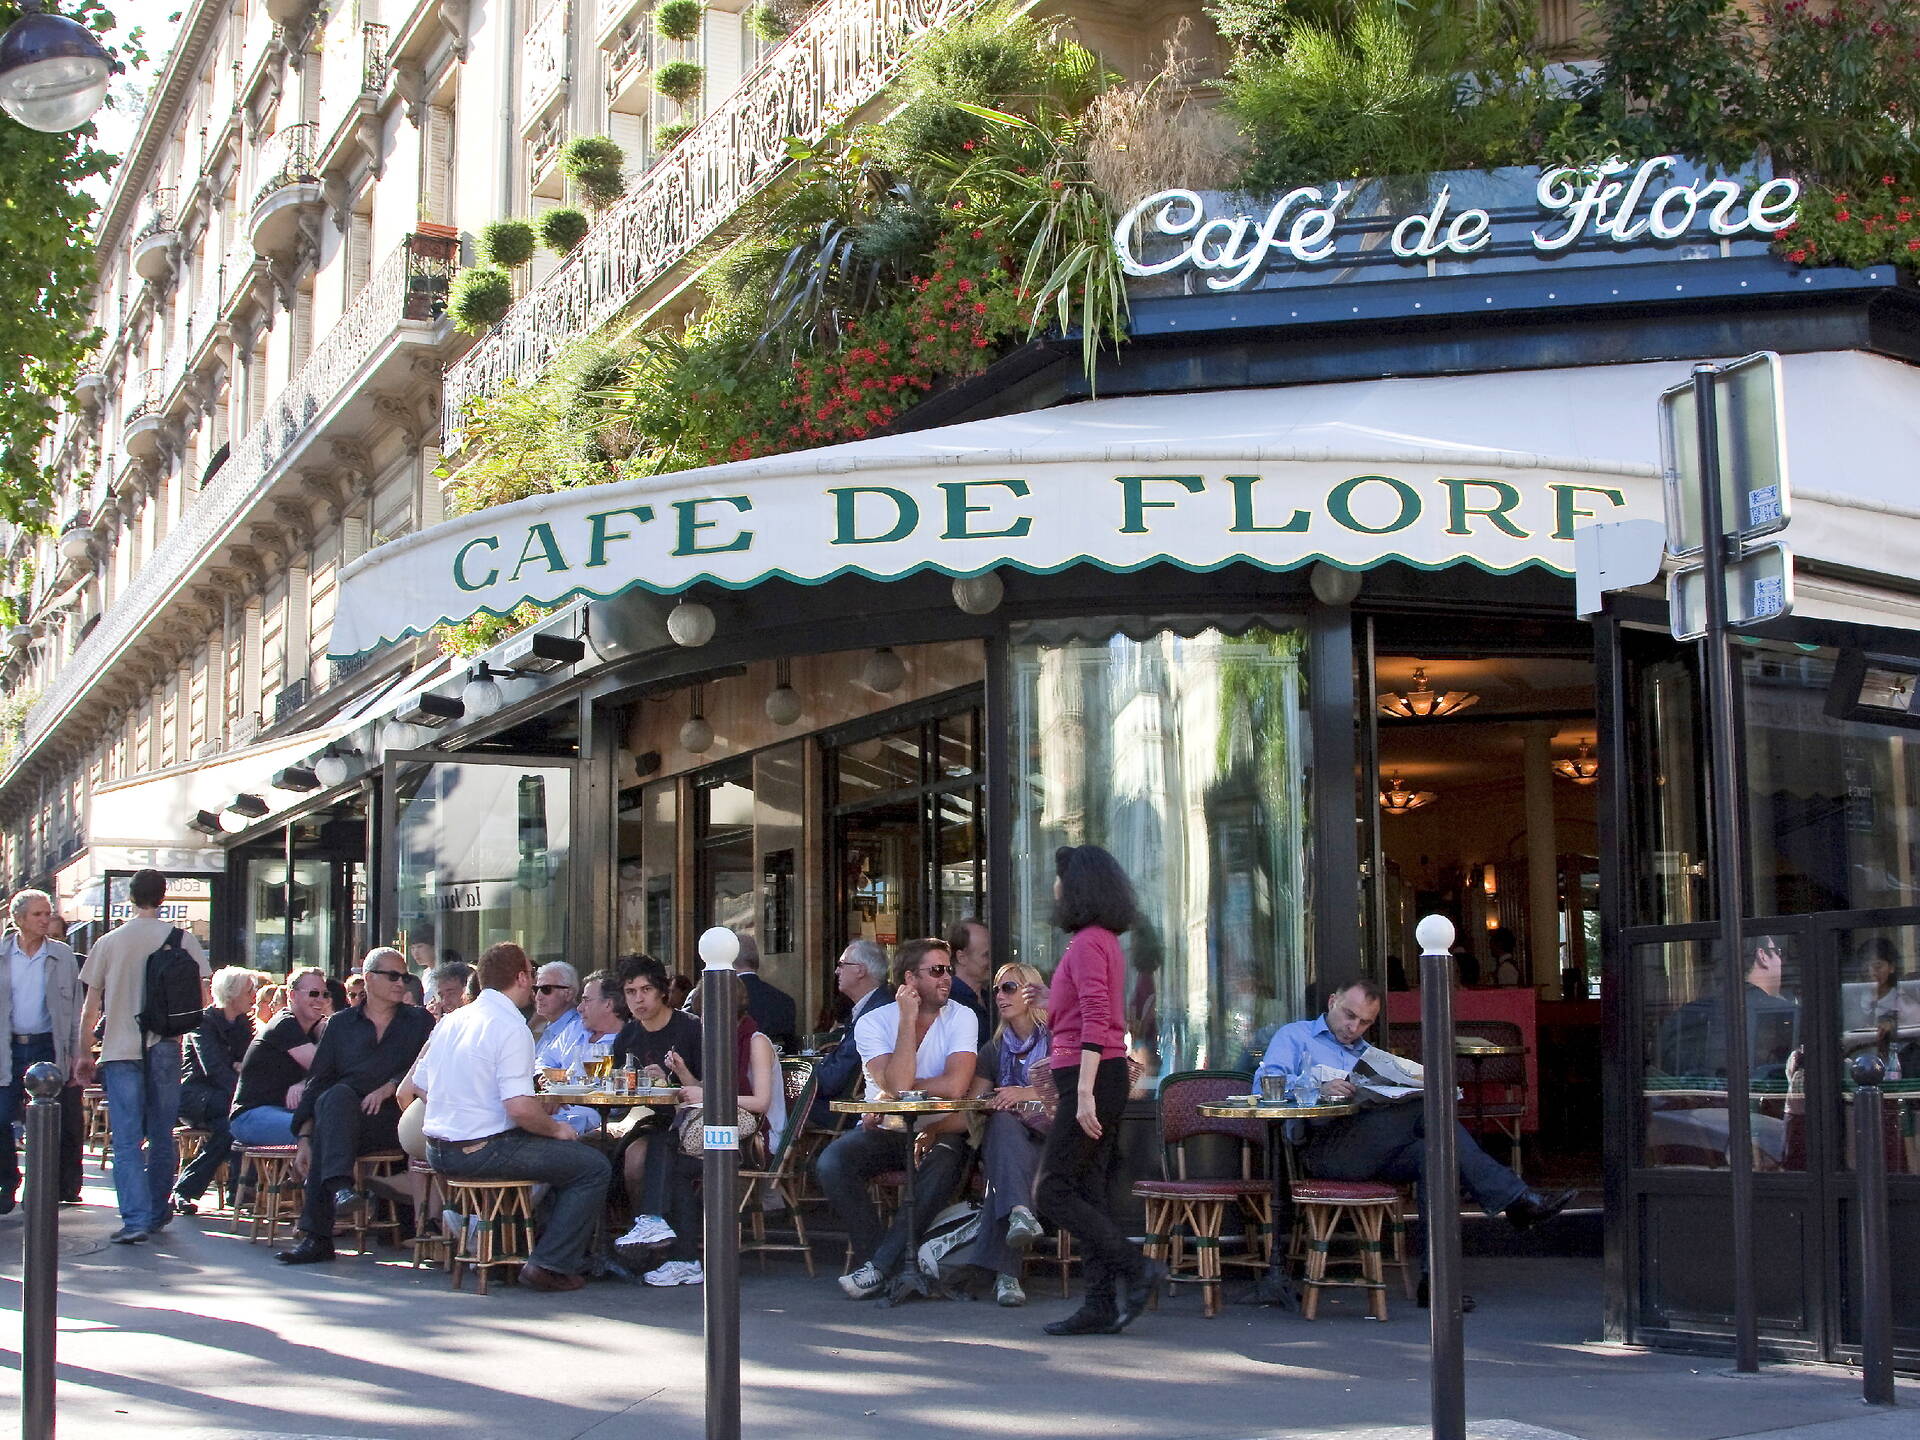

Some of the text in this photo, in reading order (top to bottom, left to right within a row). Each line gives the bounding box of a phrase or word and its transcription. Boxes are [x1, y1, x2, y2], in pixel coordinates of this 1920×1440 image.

[1113, 154, 1800, 291] Café de Flore
[453, 495, 754, 593] CAFE
[826, 479, 1034, 547] DE
